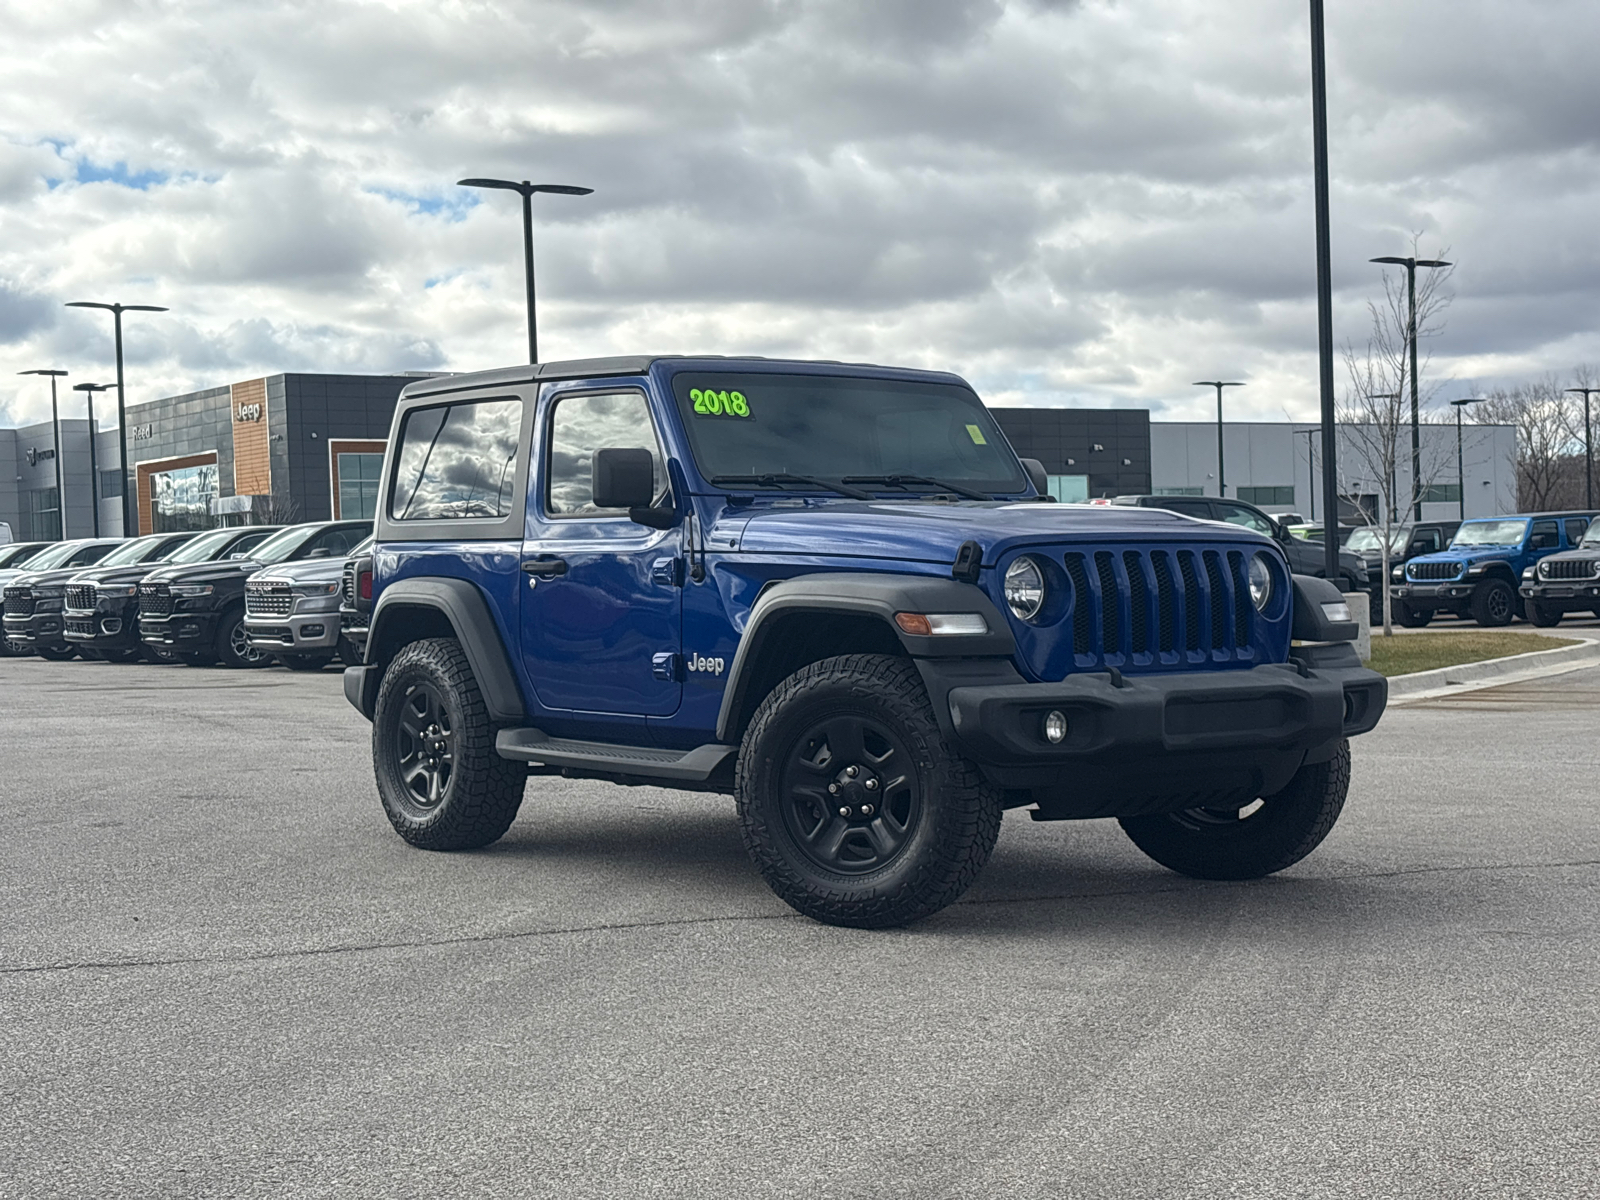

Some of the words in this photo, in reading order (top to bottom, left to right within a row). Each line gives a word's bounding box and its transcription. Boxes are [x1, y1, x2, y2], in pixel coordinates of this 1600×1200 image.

[236, 402, 260, 422] Jeep
[690, 388, 750, 418] 2018
[133, 424, 153, 441] Reed
[687, 652, 725, 676] Jeep
